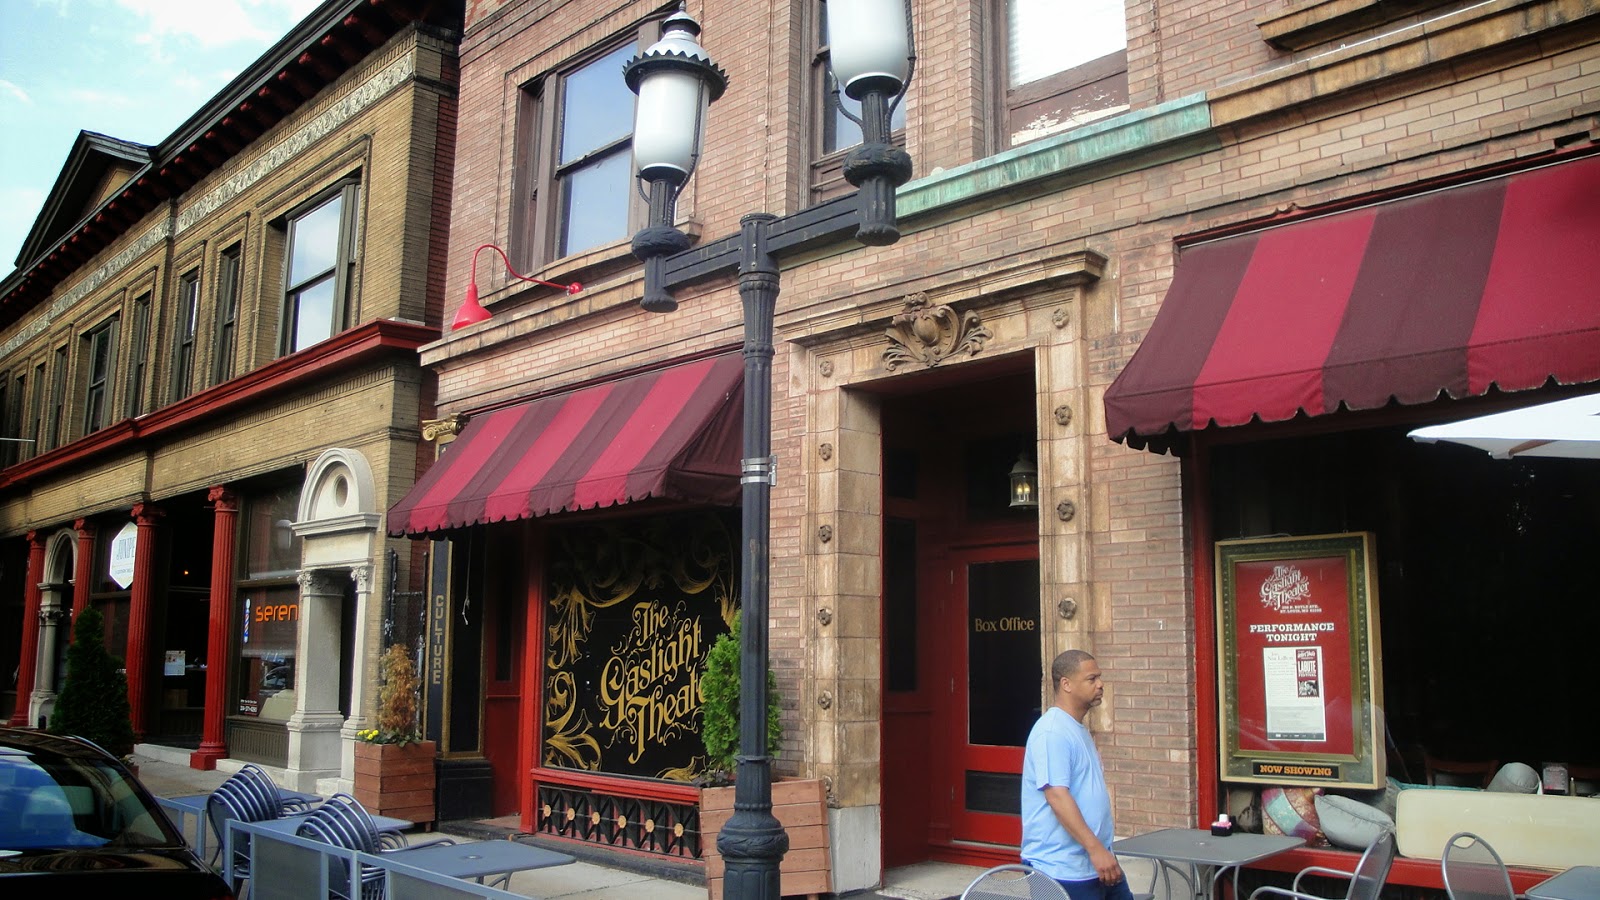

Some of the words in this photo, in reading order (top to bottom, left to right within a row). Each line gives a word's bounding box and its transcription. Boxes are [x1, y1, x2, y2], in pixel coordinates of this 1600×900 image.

[1274, 565, 1289, 580] The
[1261, 570, 1302, 602] Gaslight
[1272, 582, 1310, 611] Theater
[632, 600, 670, 647] The
[975, 618, 997, 632] Box
[999, 617, 1035, 631] Office
[1249, 622, 1335, 633] PERFORMANCE
[432, 594, 445, 685] CULTURE
[1266, 633, 1317, 642] TONIGHT
[599, 616, 702, 730] Gaslight
[1259, 764, 1283, 774] NOW
[1283, 765, 1333, 776] SHOWING
